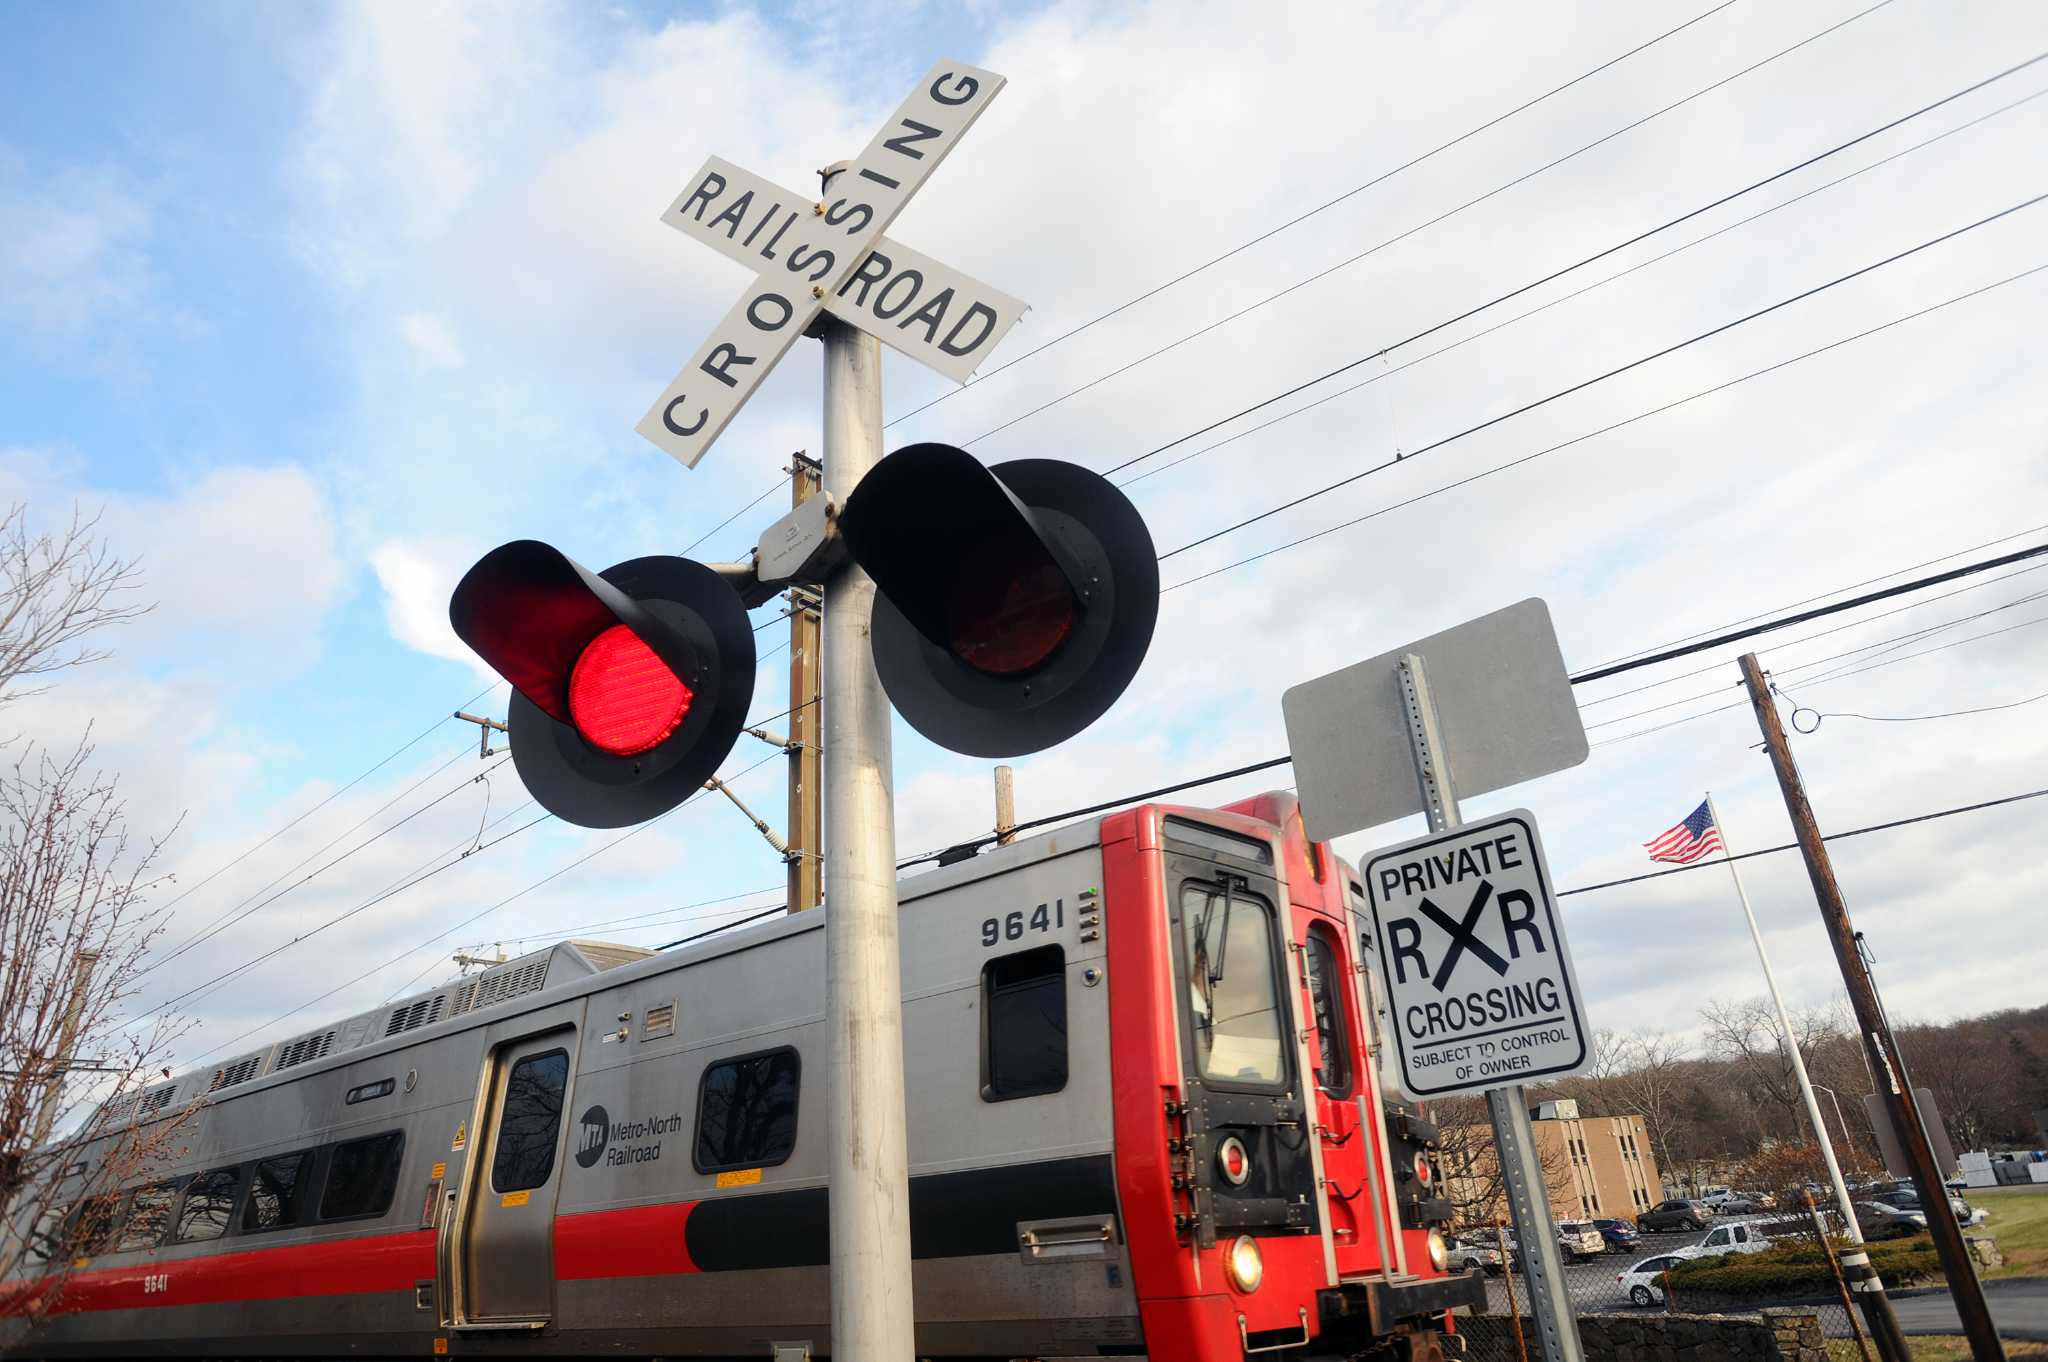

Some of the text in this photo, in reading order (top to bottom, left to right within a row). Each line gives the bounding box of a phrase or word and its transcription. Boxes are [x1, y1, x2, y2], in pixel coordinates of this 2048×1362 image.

[663, 72, 979, 436] CROSSING
[1380, 834, 1522, 902] PRIVATE
[981, 898, 1064, 947] 9641
[1406, 977, 1561, 1040] CROSSING
[1412, 1028, 1570, 1069] SUBJECT TO CONTROL
[1456, 1055, 1532, 1080] OF OWNER
[609, 1112, 682, 1142] Metro-North
[606, 1140, 661, 1167] Railroad
[144, 1274, 168, 1293] 9641
